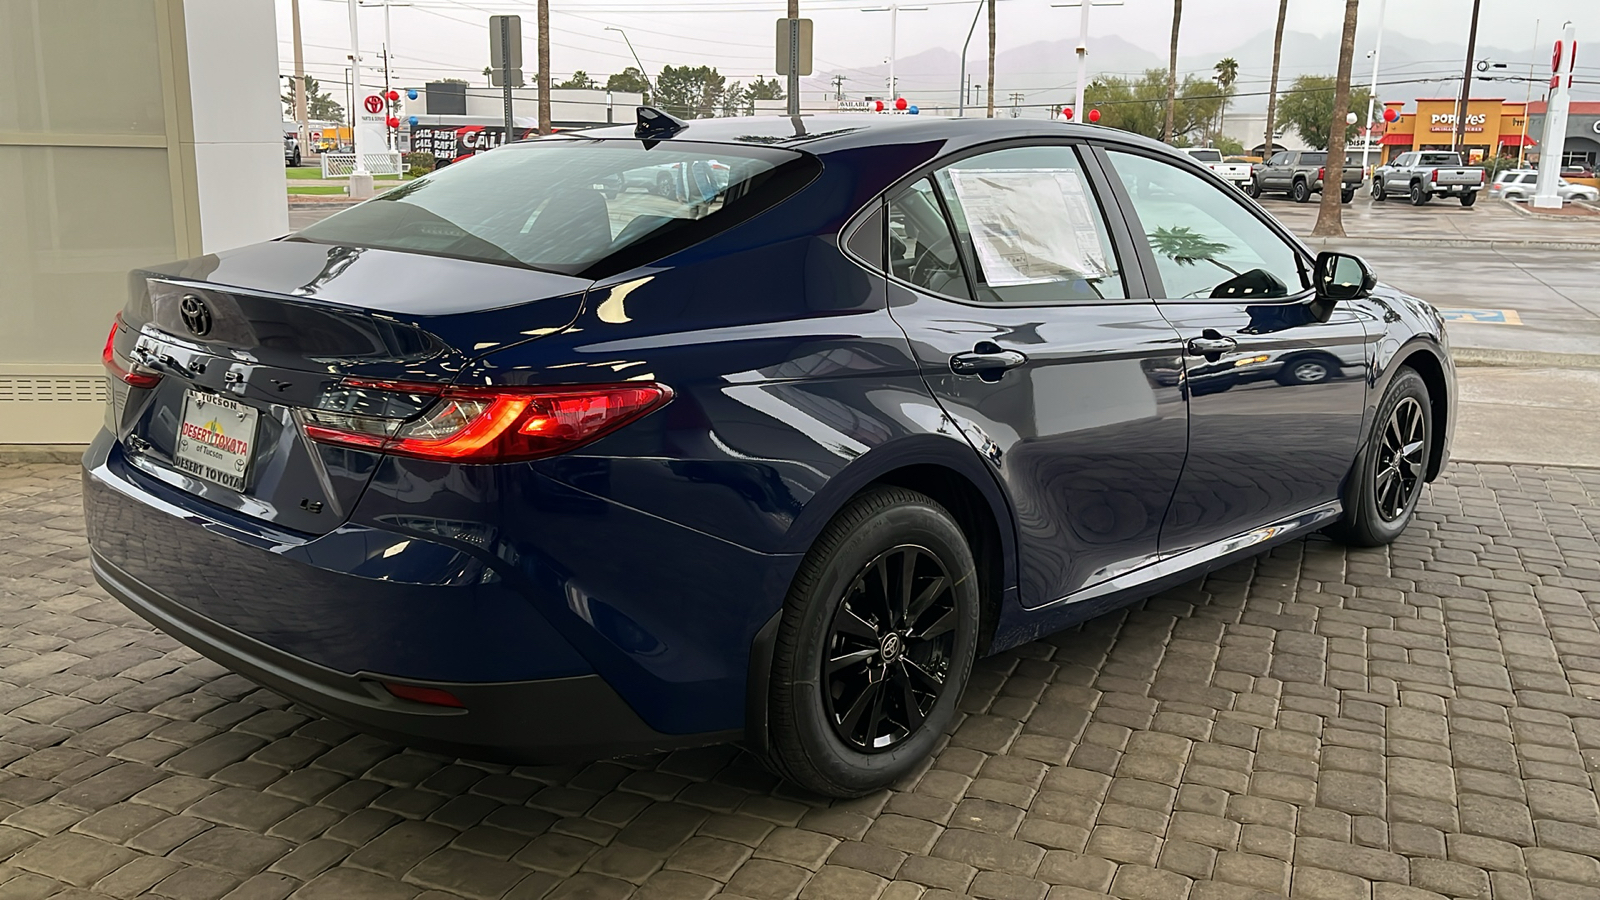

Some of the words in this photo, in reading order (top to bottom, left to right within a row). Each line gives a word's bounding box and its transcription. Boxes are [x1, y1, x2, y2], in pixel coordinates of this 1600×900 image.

[201, 393, 237, 410] TUCSON
[182, 422, 212, 444] DESERT
[213, 432, 248, 456] TOYOTA
[196, 445, 204, 453] of
[204, 446, 223, 460] Tucson
[176, 456, 204, 475] DESERT
[206, 467, 241, 489] TOYOTA
